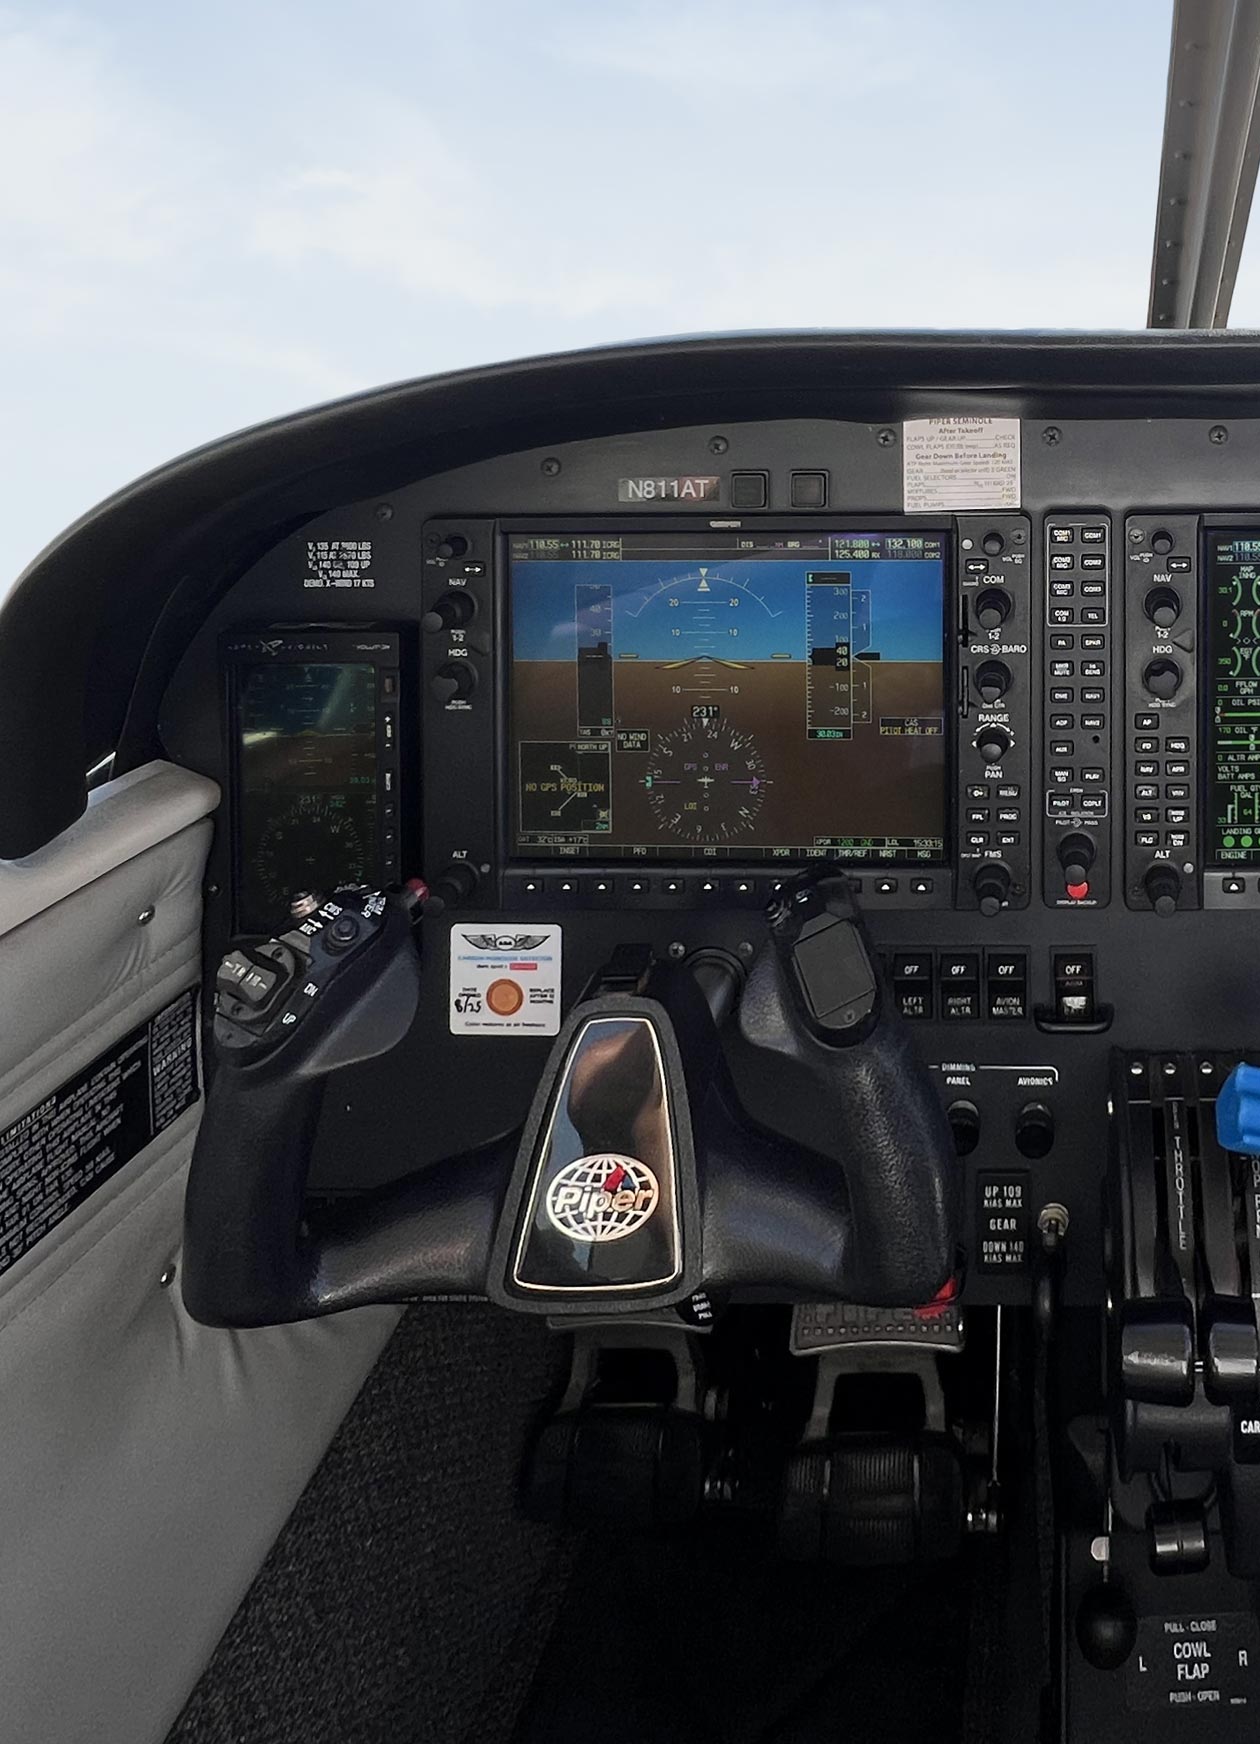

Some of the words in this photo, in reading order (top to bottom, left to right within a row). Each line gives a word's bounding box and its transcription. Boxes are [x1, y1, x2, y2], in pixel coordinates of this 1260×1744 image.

[628, 479, 709, 499] N811AT
[983, 575, 1005, 584] COM
[1153, 574, 1172, 583] NAV
[1152, 645, 1173, 654] HDG
[671, 686, 681, 694] 10
[729, 686, 739, 694] 10
[978, 713, 1009, 722] RANGE
[617, 732, 628, 741] NO
[629, 732, 647, 741] WIND
[623, 740, 641, 749] DATA
[1217, 765, 1240, 773] VOLTS
[984, 770, 1003, 779] PAN
[525, 783, 538, 792] NO
[540, 783, 558, 792] GPS
[560, 783, 605, 792] POSITION
[1221, 827, 1252, 835] LANDING
[452, 850, 468, 859] ALT
[633, 847, 647, 855] PFD
[917, 850, 931, 858] MSG
[1154, 850, 1171, 858] ALT
[1221, 851, 1248, 860] ENGINE
[992, 1006, 1024, 1015] MASTER
[1017, 1076, 1054, 1086] AVIONICS
[984, 1185, 999, 1198] UP
[1173, 1136, 1188, 1251] THROTTLE
[554, 1186, 655, 1219] Piper
[1005, 1199, 1023, 1208] MAX
[989, 1218, 1017, 1231] GEAR
[982, 1241, 1007, 1253] DOWN
[1005, 1254, 1023, 1263] MAX
[1173, 1641, 1212, 1659] COWL
[1238, 1649, 1248, 1667] R
[1138, 1655, 1148, 1673] L
[1176, 1663, 1210, 1681] FLAP
